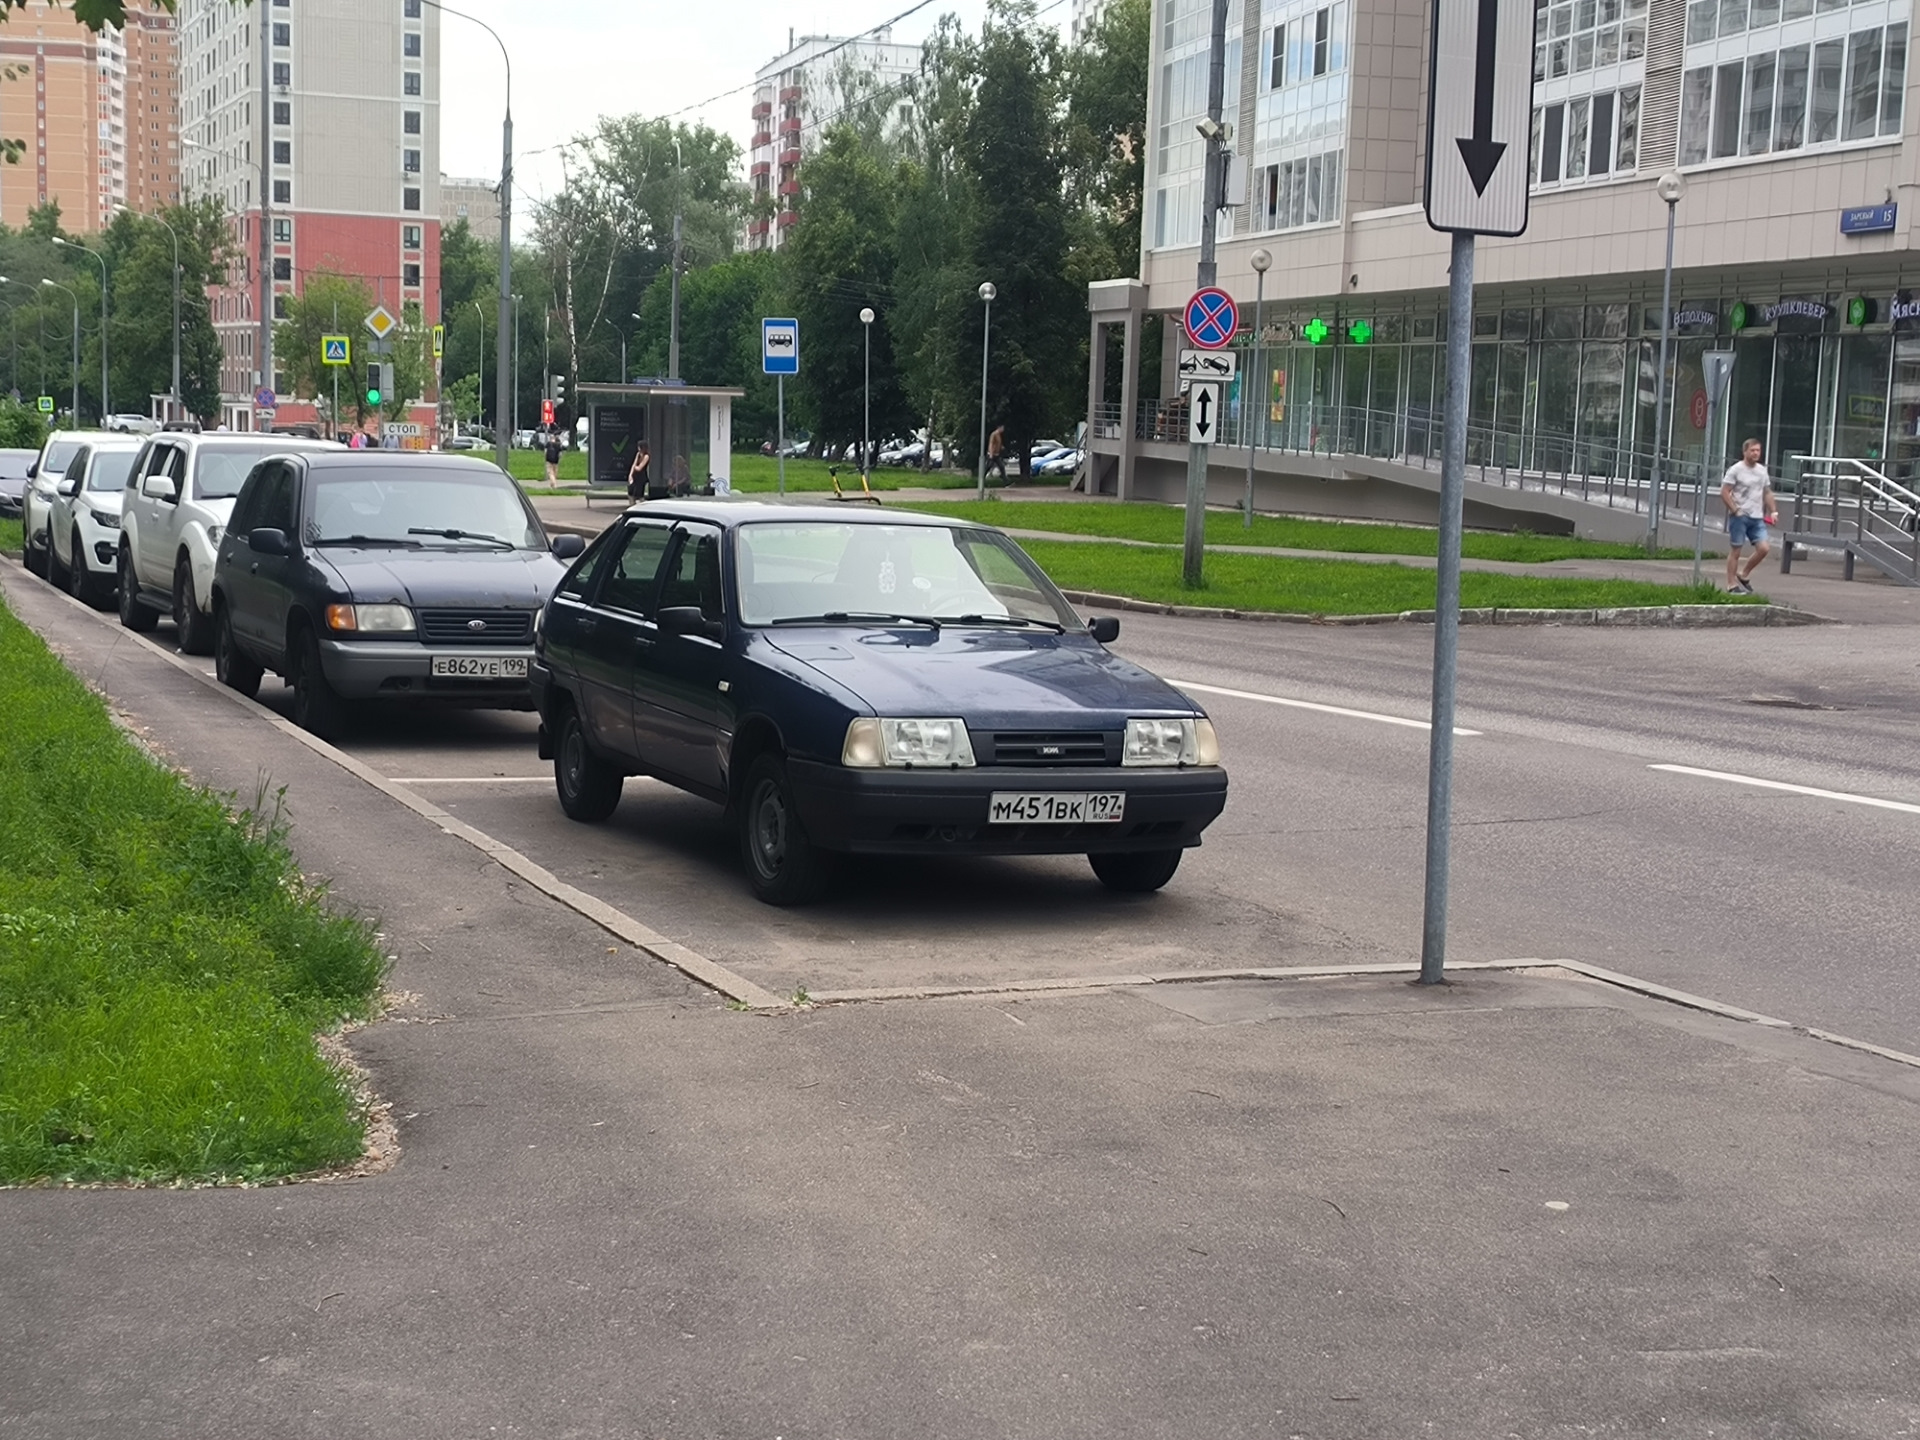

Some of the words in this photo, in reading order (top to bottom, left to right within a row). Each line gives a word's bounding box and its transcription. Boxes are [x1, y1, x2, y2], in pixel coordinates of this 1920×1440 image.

[1884, 209, 1892, 222] 15
[1673, 310, 1714, 325] ОТДОХНИ
[388, 424, 417, 434] СТОП
[502, 659, 524, 672] 199
[1089, 795, 1120, 813] 197
[1092, 812, 1109, 820] RUS
